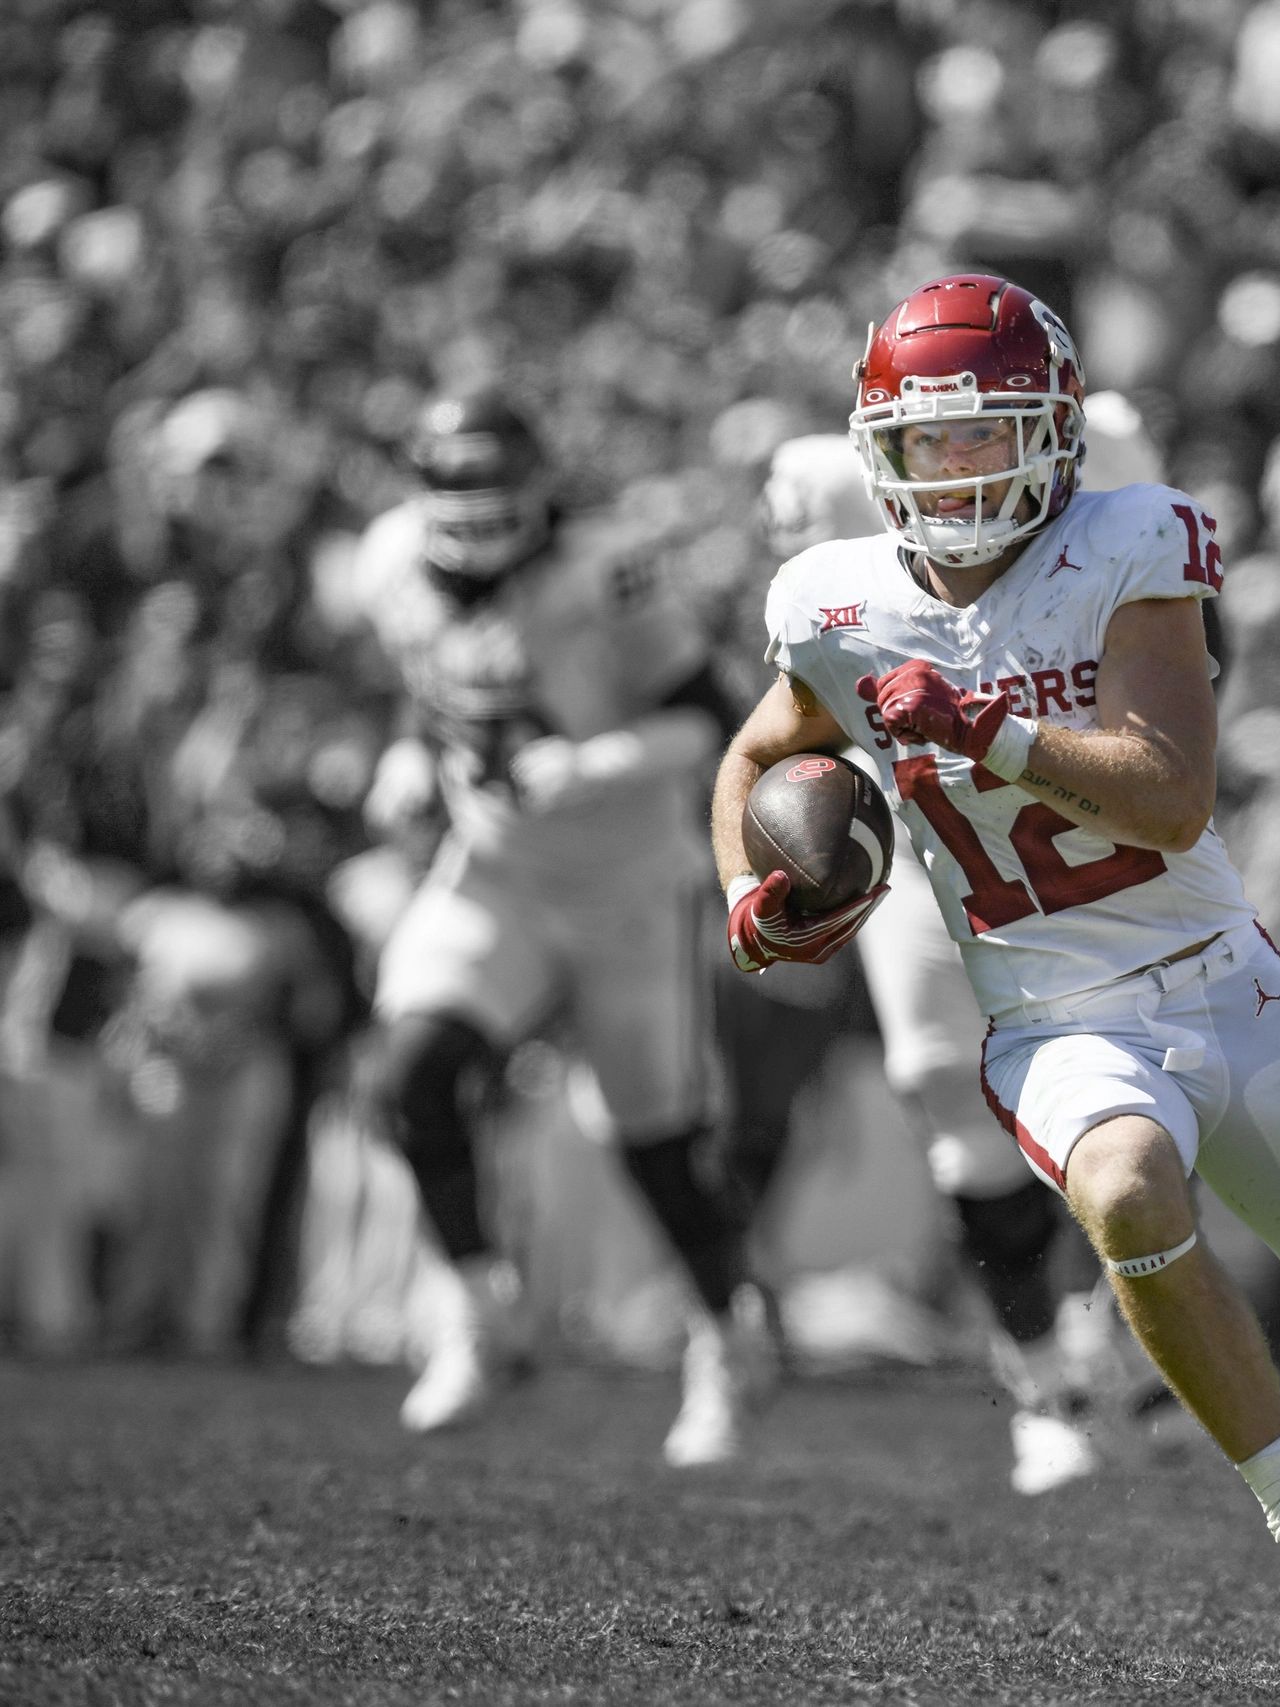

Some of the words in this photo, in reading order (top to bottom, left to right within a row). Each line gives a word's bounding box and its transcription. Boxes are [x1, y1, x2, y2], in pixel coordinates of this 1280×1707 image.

[819, 603, 863, 633] XII
[864, 660, 1098, 750] SERS
[891, 754, 1168, 936] 12
